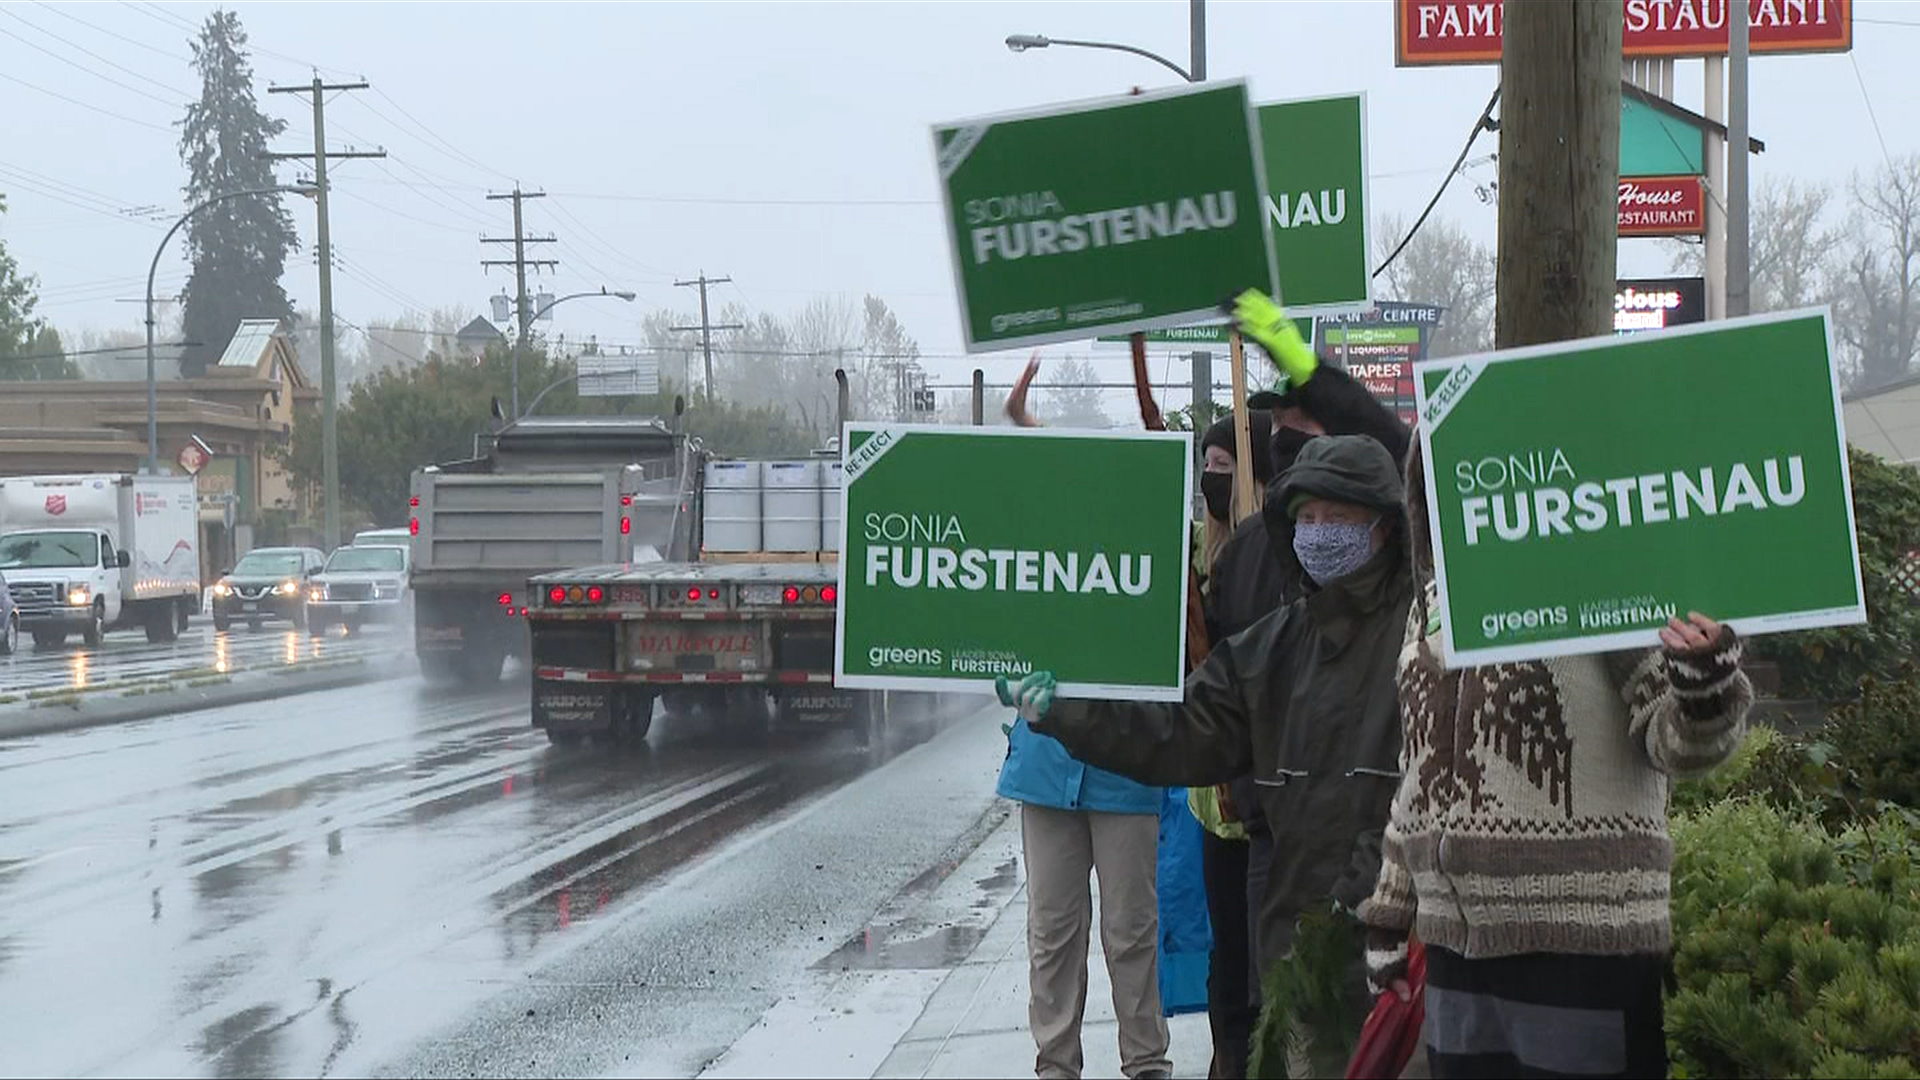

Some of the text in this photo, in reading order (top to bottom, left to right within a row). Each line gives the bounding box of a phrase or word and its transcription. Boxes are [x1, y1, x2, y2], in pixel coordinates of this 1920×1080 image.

[1418, 0, 1834, 38] FAM STAUANT
[964, 190, 1064, 224] SONIA
[1617, 182, 1683, 206] House
[971, 190, 1239, 265] FURSTENAU
[1616, 210, 1695, 225] ESTAURANT
[1383, 308, 1436, 321] CENTRE
[1165, 327, 1219, 339] FURSTENAU
[1423, 363, 1473, 423] RE-ELECT
[845, 429, 893, 476] RE-ELECT
[1455, 447, 1576, 495] SONIA
[1461, 454, 1807, 546] FURSTENAU
[864, 512, 967, 544] SONIA
[865, 544, 1153, 597] FURSTENAU
[1481, 605, 1569, 639] greens
[1580, 602, 1677, 630] FURSTENAU
[638, 635, 757, 655] MARPOLE
[868, 646, 943, 668] greens
[951, 659, 1032, 675] FURSTENAU
